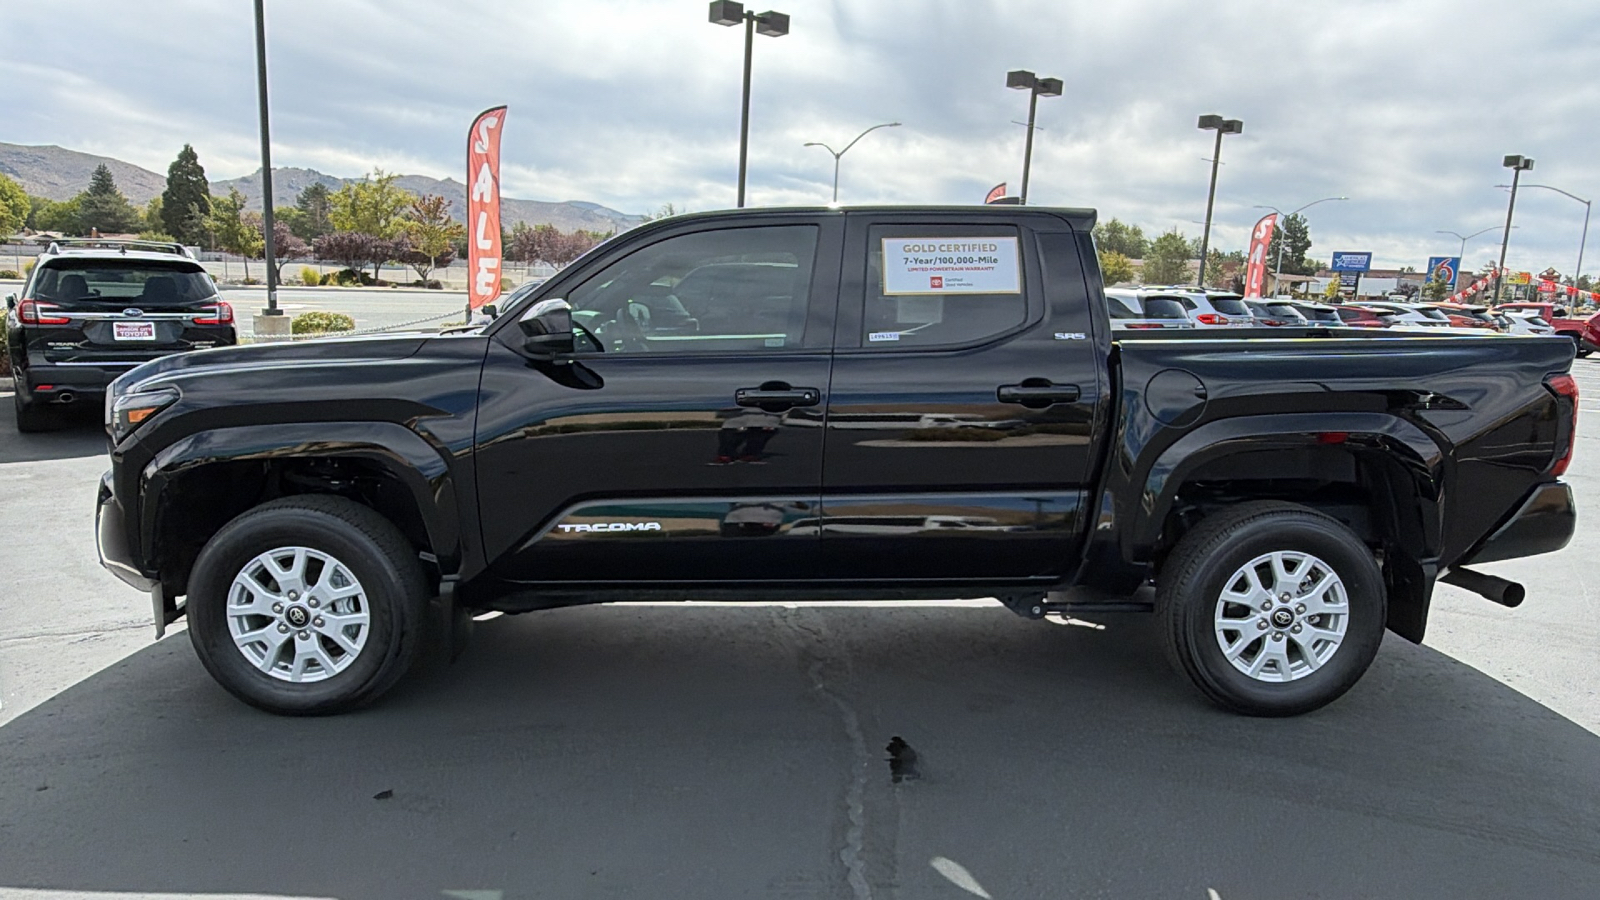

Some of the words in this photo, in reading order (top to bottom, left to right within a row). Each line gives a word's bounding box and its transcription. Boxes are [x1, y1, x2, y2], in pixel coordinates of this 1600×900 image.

[472, 116, 498, 296] SALE
[903, 244, 936, 253] GOLD
[938, 243, 997, 253] CERTIFIED
[903, 256, 998, 265] 7-Year/100,000-Mile
[1249, 219, 1272, 297] SAL
[1432, 257, 1454, 284] 6
[558, 522, 661, 533] TACOMA
